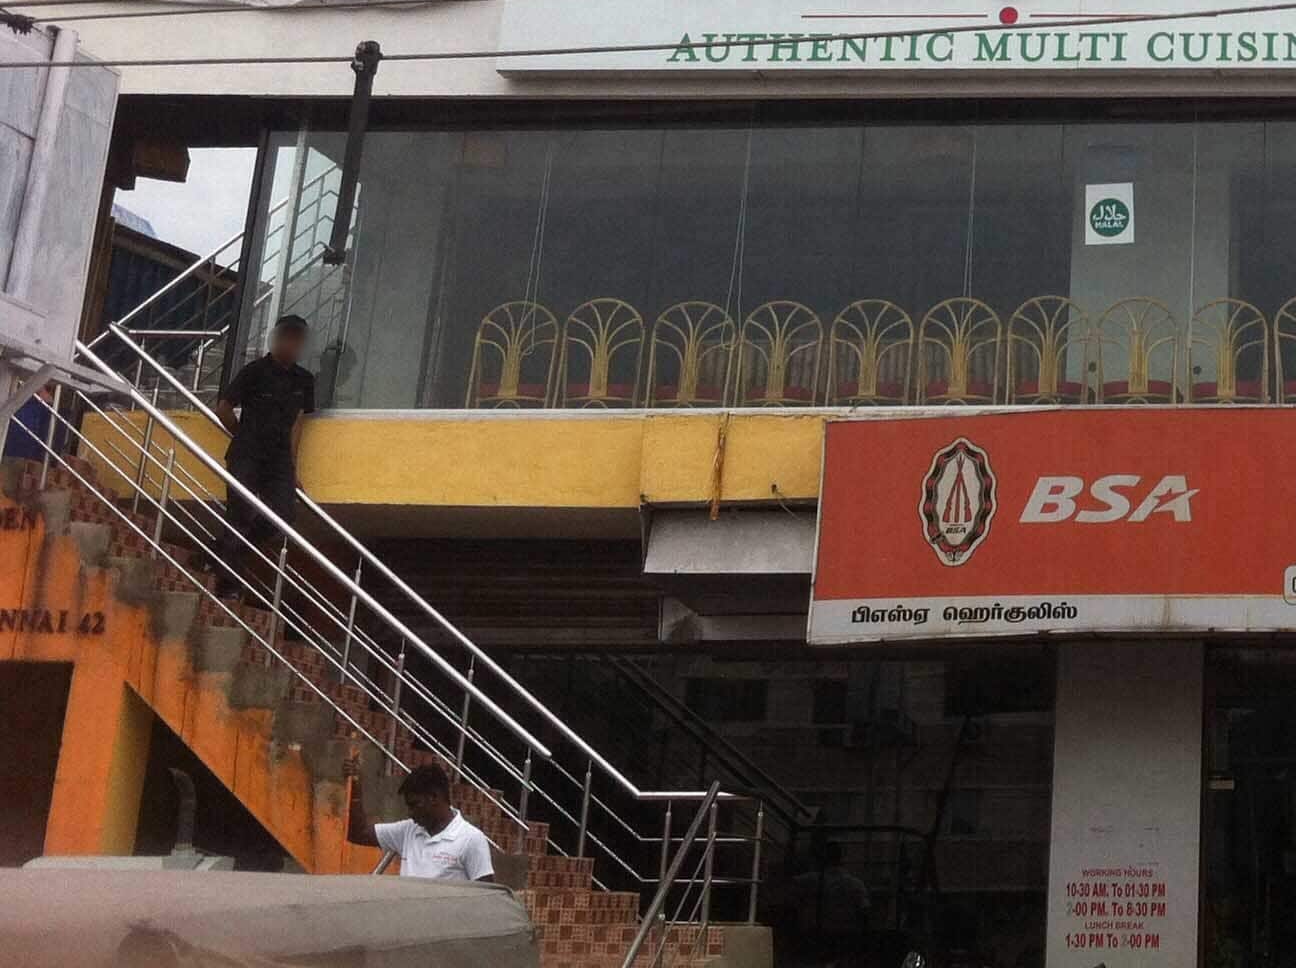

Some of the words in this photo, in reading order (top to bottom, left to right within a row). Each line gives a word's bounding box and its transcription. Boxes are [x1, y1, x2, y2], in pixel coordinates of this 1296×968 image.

[666, 31, 954, 63] AUTHENTIC
[973, 31, 1128, 63] MULTI
[1092, 204, 1126, 221] حلال
[1095, 221, 1124, 230] HALAL
[1019, 475, 1200, 523] BSA
[1082, 869, 1121, 878] WORKING
[1124, 868, 1154, 878] HOURS
[1066, 883, 1090, 898] 10-30
[1111, 883, 1123, 898] To
[1151, 883, 1166, 898] PM
[1111, 902, 1123, 917] To
[1150, 902, 1166, 917] PM
[1084, 921, 1113, 930] LUNCH
[1065, 934, 1086, 948] 1-30
[1089, 934, 1104, 948] PM
[1106, 934, 1118, 948] To
[1144, 934, 1160, 949] PM
